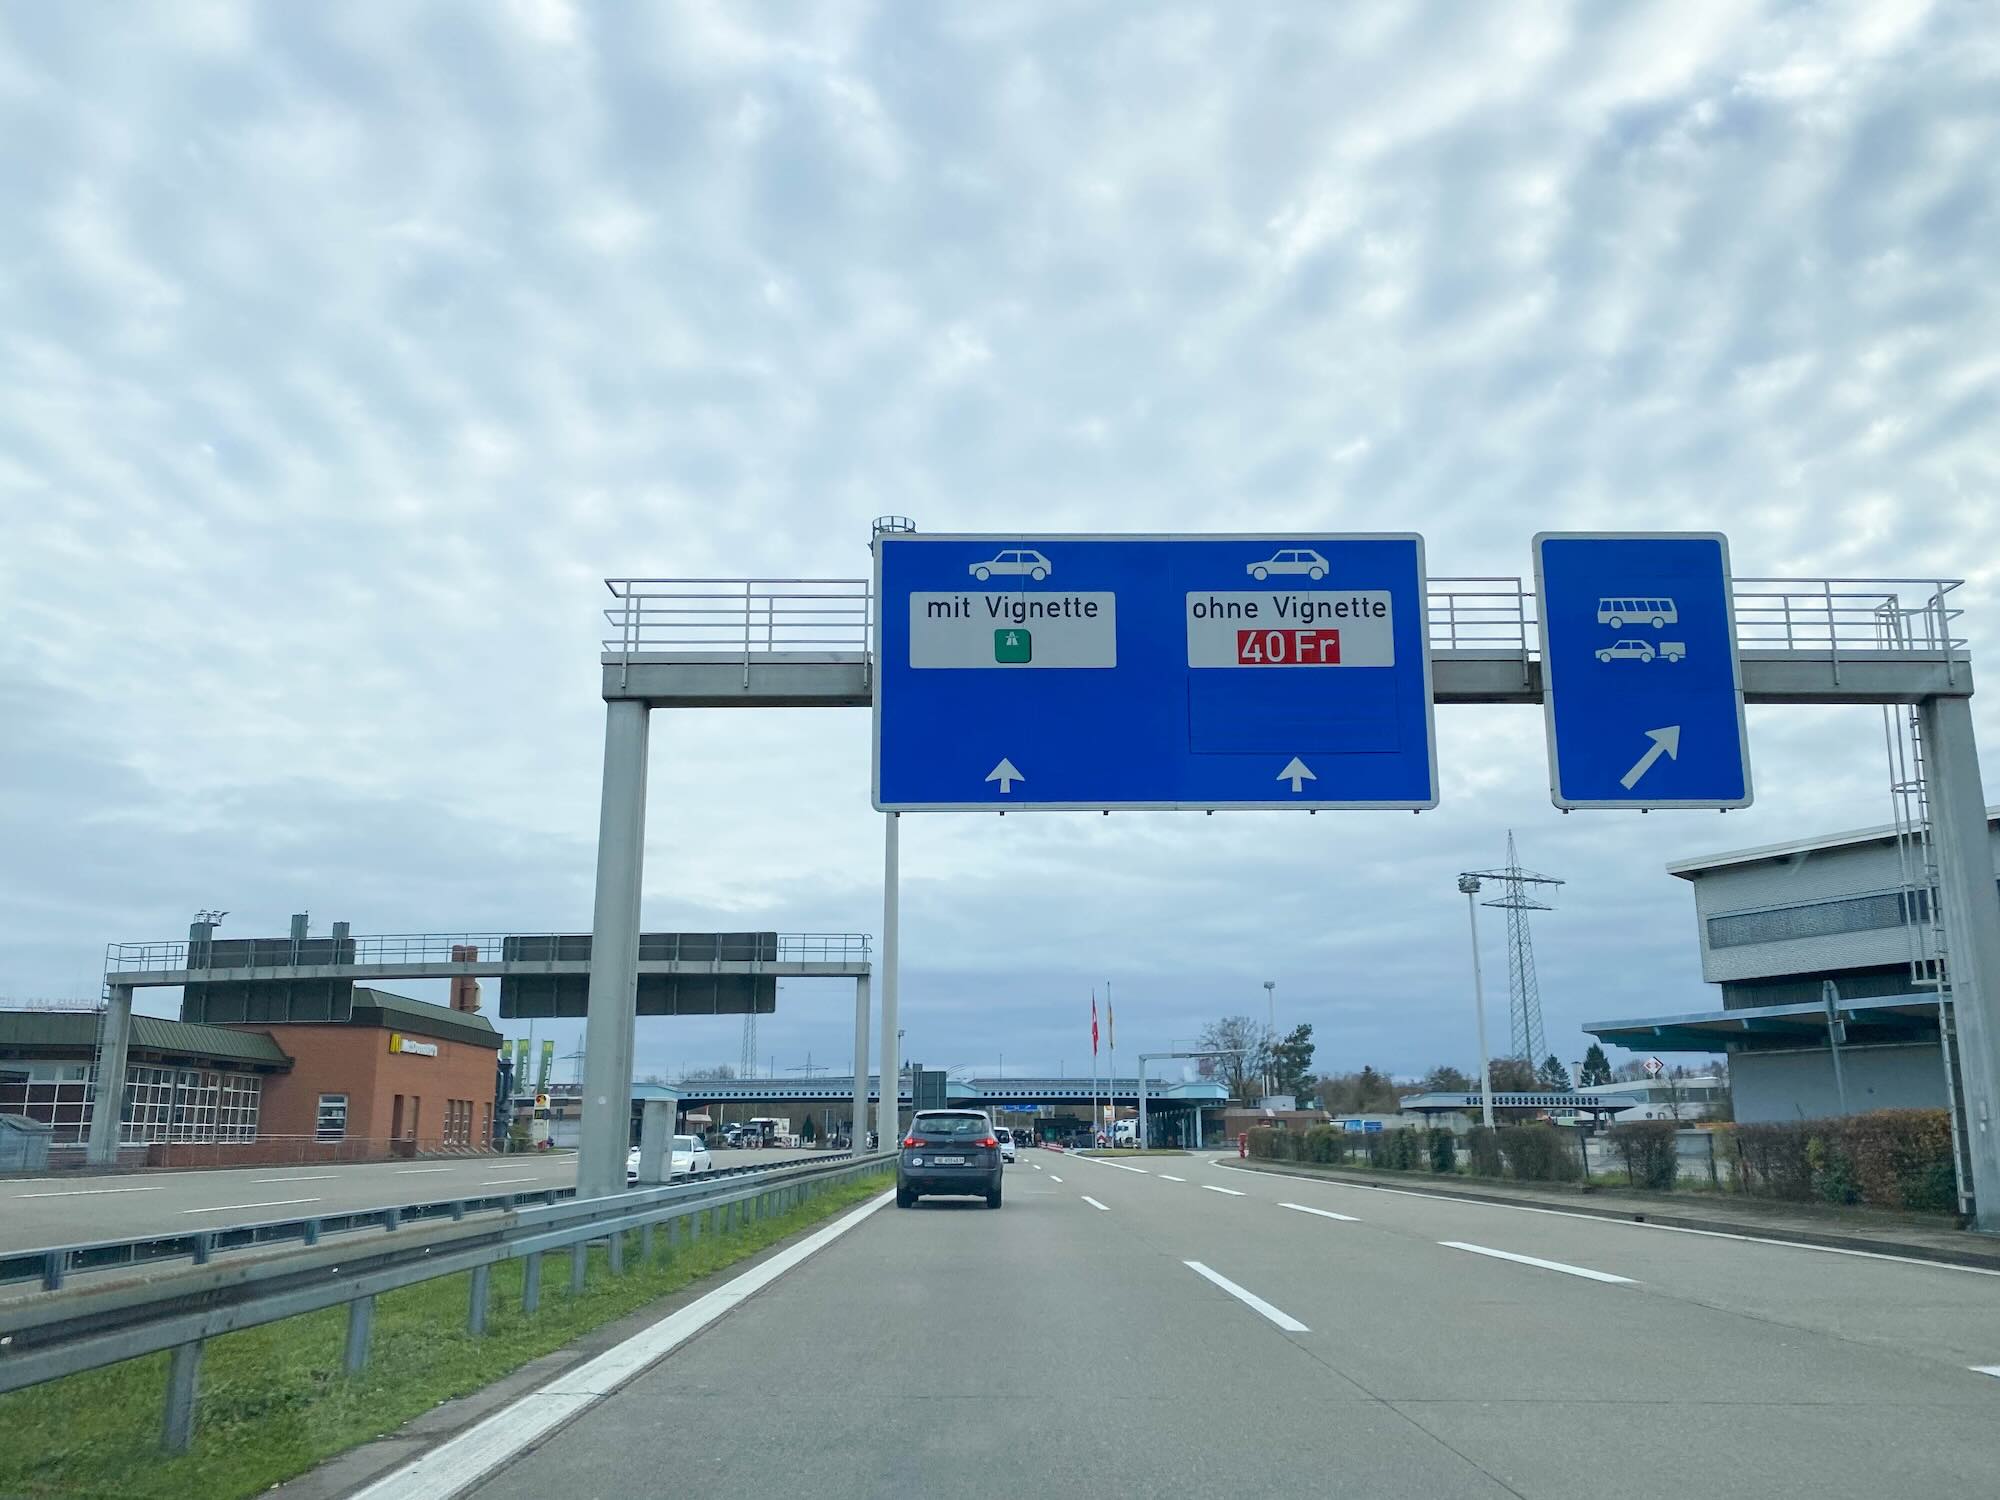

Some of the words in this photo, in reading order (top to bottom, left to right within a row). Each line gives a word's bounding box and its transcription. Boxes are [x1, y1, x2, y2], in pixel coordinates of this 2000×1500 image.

[927, 596, 970, 618] mit
[985, 596, 1098, 624] Vignette
[1192, 596, 1259, 618] ohne
[1273, 596, 1387, 624] Vignette
[1241, 630, 1286, 663] 40
[1295, 630, 1336, 663] Fr
